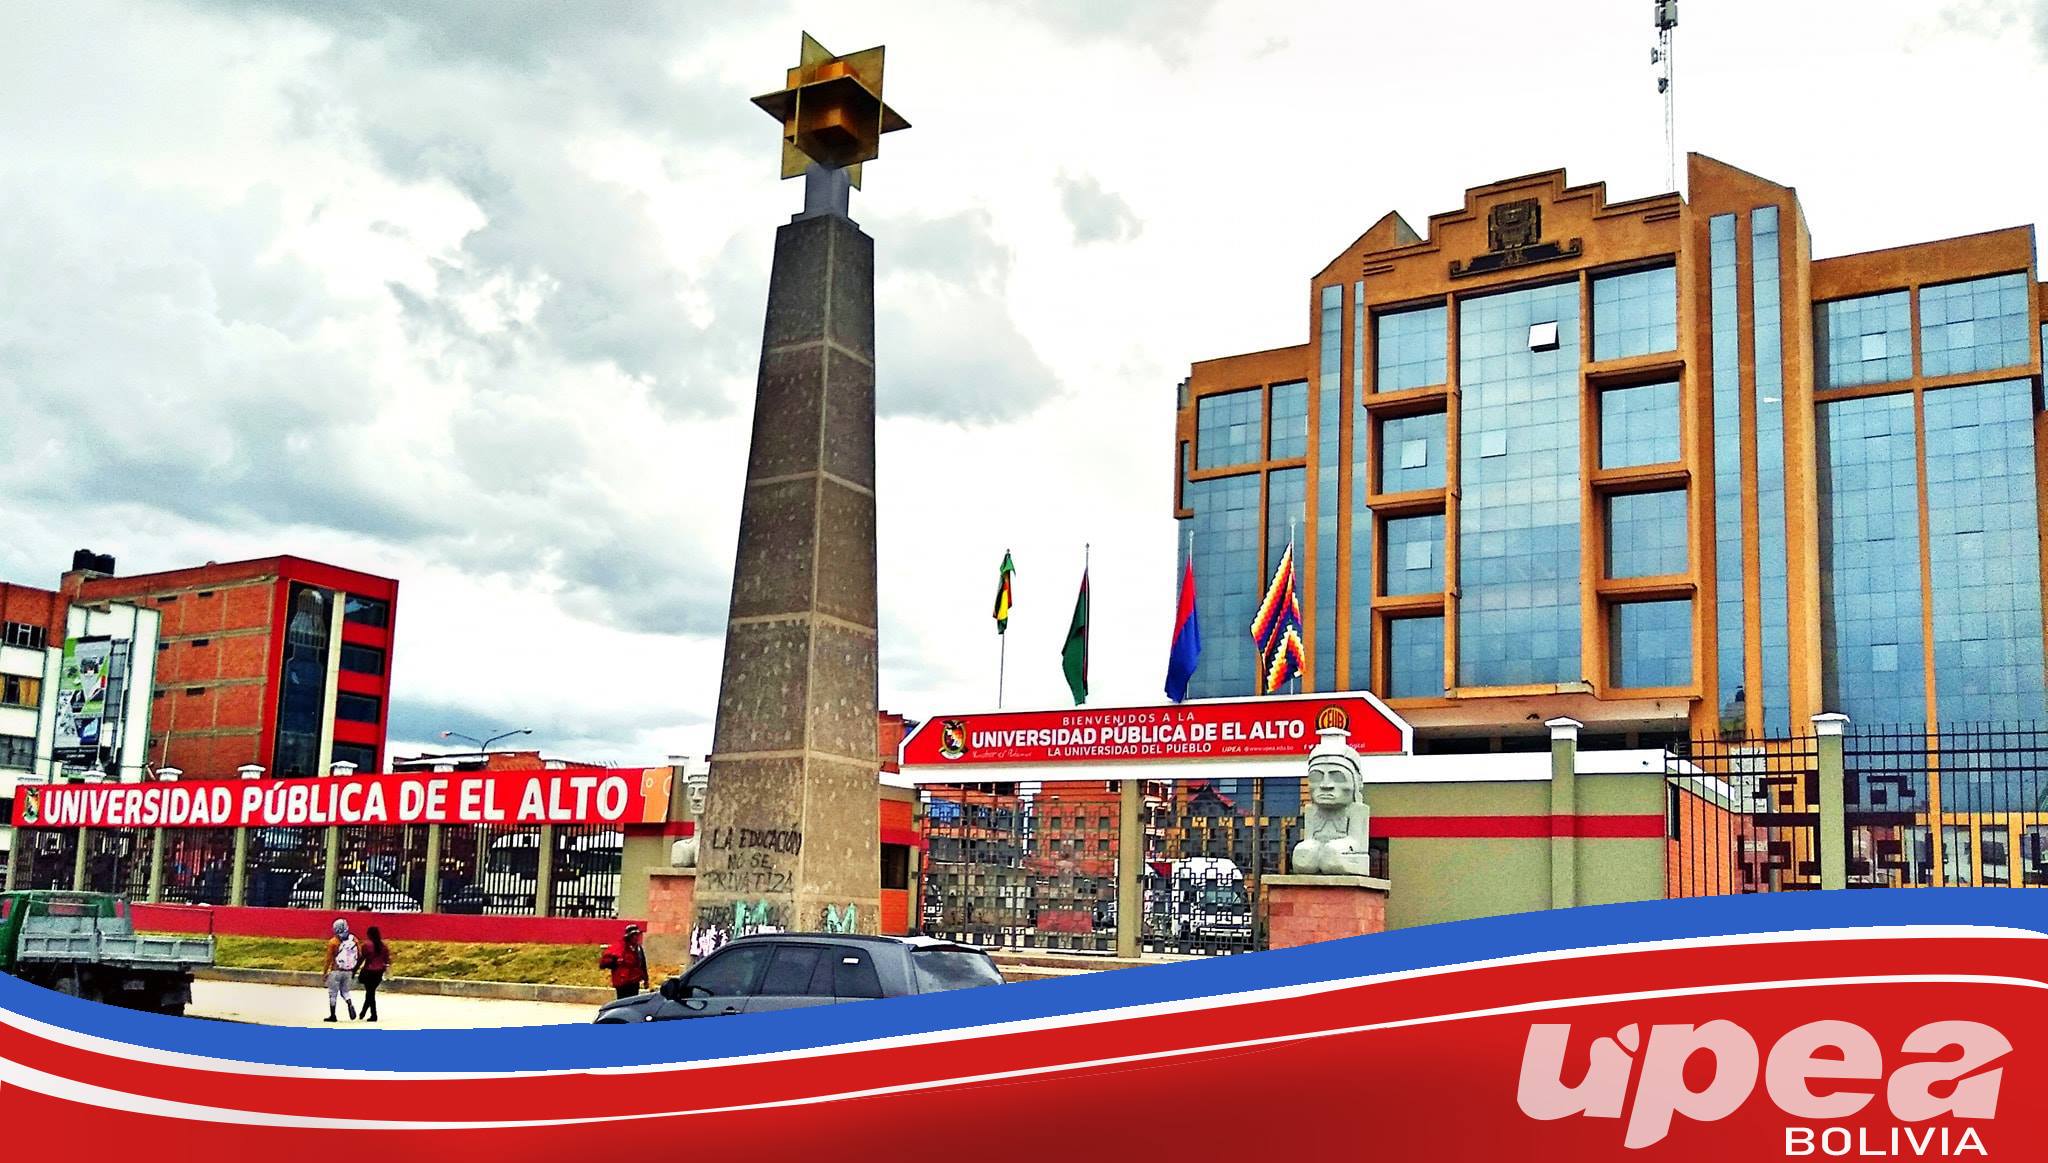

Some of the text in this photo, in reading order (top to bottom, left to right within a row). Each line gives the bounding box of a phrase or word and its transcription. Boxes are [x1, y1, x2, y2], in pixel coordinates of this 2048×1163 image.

[1062, 712, 1195, 726] BIENVENIDOS A LA
[971, 719, 1305, 748] UNIVERSIDAD PÚBLICA DE EL ALTO
[1047, 742, 1212, 757] LA UNIVERSIDAD DEL PUEBLO
[43, 775, 629, 825] UNIVERSIDAD PÚBLICA DE EL ALTO
[713, 826, 733, 850] LA
[751, 852, 773, 870] SE
